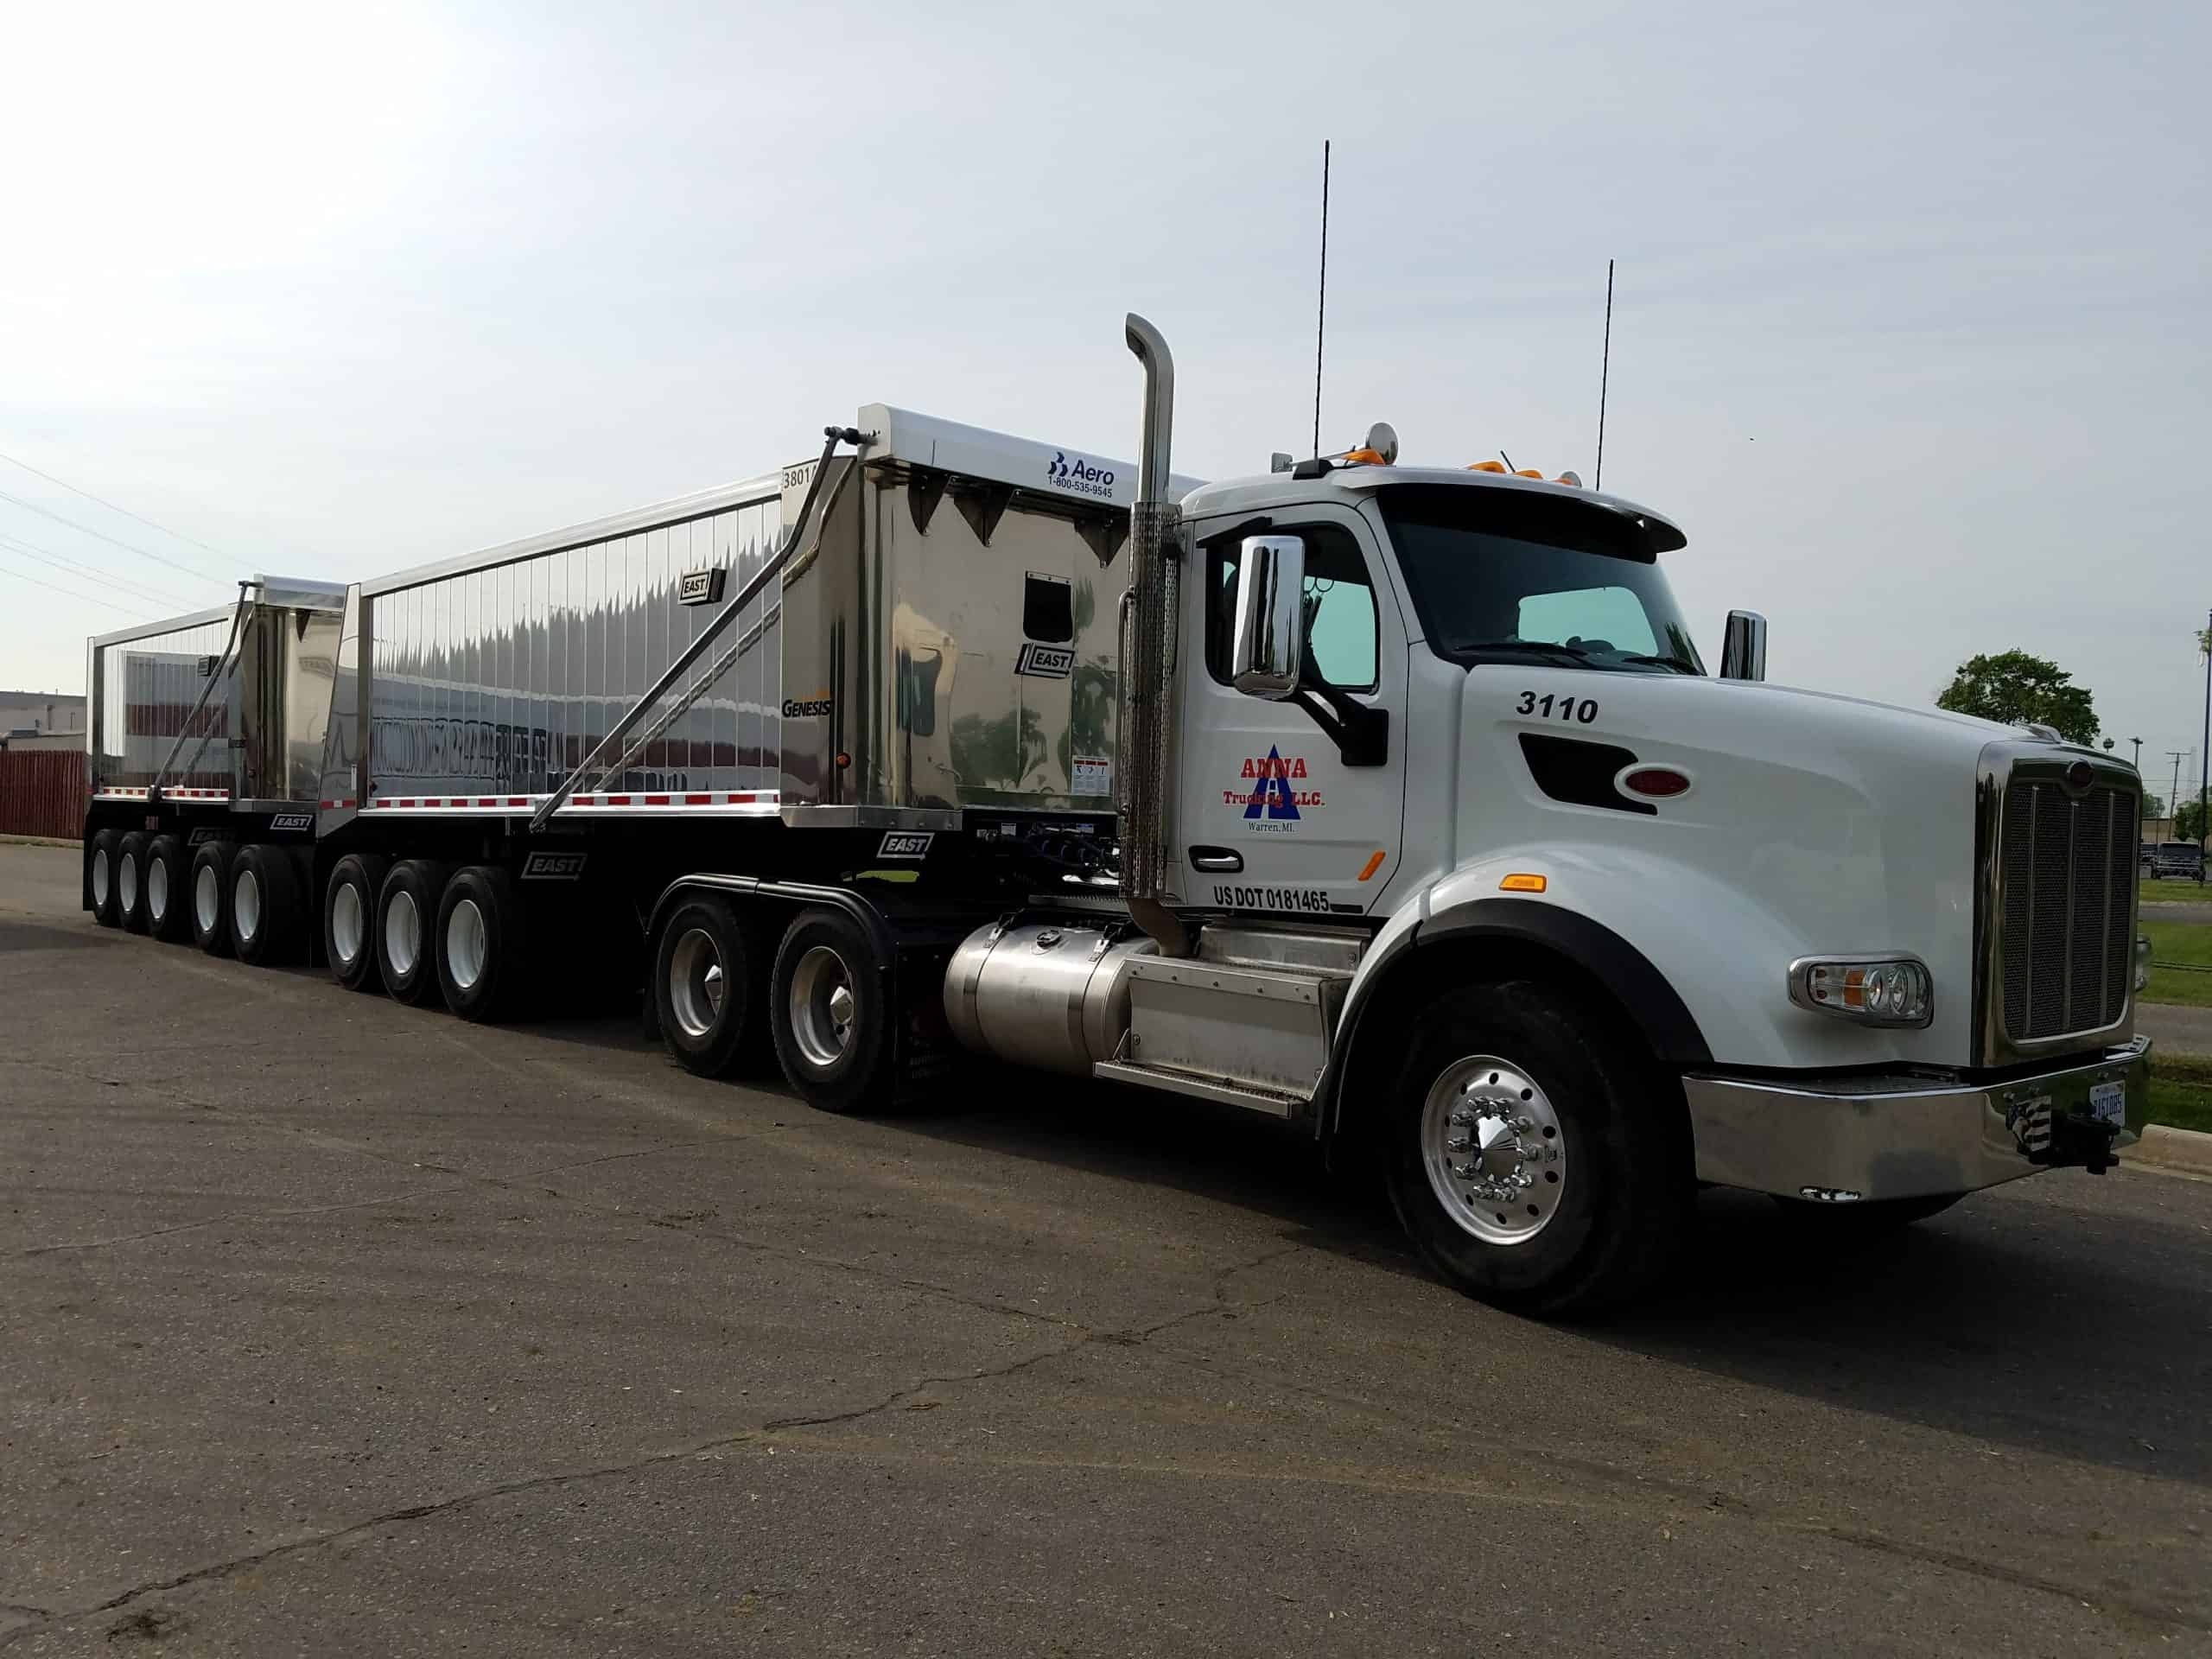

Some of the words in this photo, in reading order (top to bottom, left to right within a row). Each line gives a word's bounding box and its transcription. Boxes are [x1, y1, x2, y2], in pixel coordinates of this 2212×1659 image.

[1071, 459, 1115, 486] Aero
[1047, 475, 1113, 499] 1-800-535-9545
[683, 578, 706, 594] EAST
[1035, 652, 1069, 668] EAST
[781, 698, 835, 718] GENESIS
[1516, 690, 1599, 724] 3110
[1240, 758, 1307, 779] ANNA
[1223, 791, 1284, 809] Trucking
[276, 817, 307, 827] EAST
[886, 837, 926, 852] EAST
[531, 858, 580, 872] EAST
[1214, 886, 1233, 906] US
[1235, 887, 1264, 907] DOT
[1266, 888, 1329, 912] 0181465
